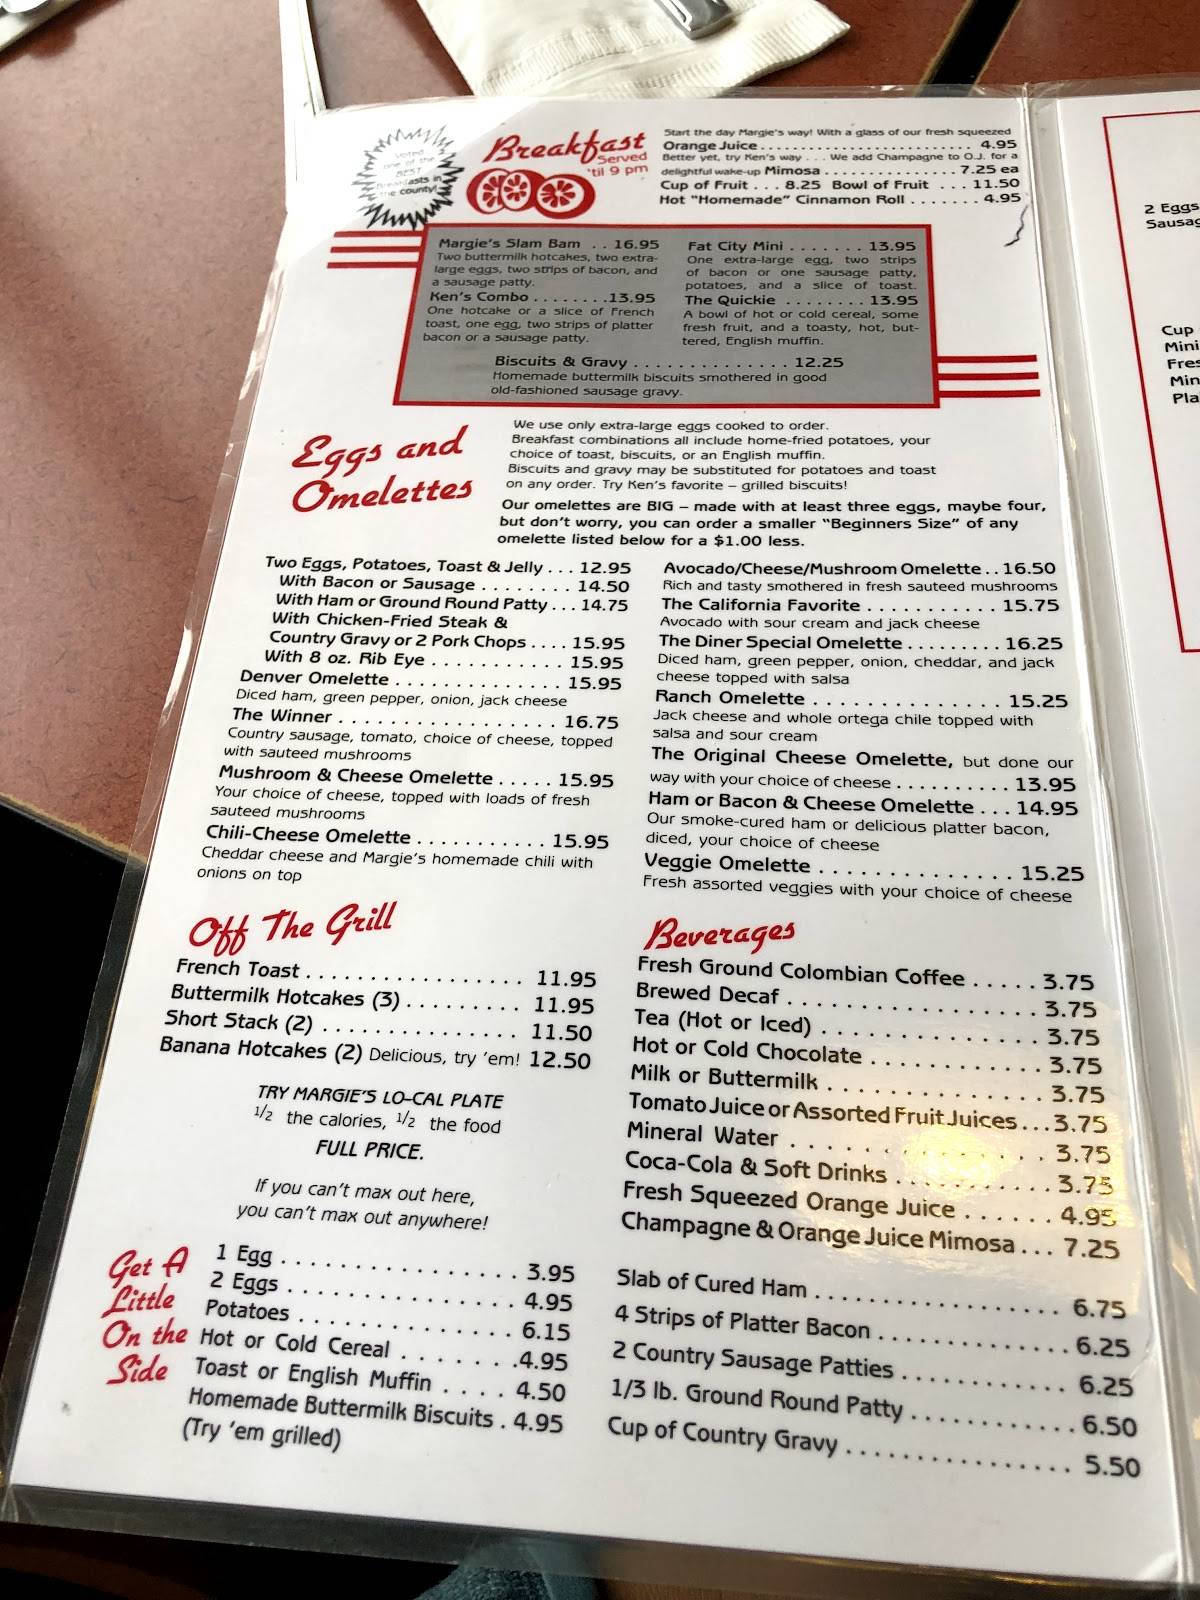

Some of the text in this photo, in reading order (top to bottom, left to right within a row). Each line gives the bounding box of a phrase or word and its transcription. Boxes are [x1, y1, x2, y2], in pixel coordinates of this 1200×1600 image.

[715, 129, 736, 137] day
[738, 129, 784, 138] Margie's
[787, 129, 813, 138] way!
[855, 129, 885, 138] glass
[958, 128, 1012, 137] squeezed
[482, 129, 646, 164] Breakfast
[663, 140, 1017, 152] Orange Juice 4.95
[598, 152, 648, 164] Served
[588, 165, 648, 177] 'til 9 pm
[660, 178, 1020, 192] Cup of Fruit 8.25 Bowl of Fruit 11.50
[660, 192, 1021, 204] Hot "Homemade" Cinnamon Roll 4.95
[1144, 203, 1200, 214] 2 Eggs
[438, 238, 660, 250] Margie's Slam Bam 16.95
[688, 240, 919, 254] Fat City Mini 13.95
[436, 252, 658, 265] Two buttermilk hotcakes, two extra-
[684, 294, 918, 308] The Quickie 13.95
[1162, 325, 1194, 337] Cup
[1165, 340, 1199, 352] Mini
[494, 355, 844, 371] Biscuits & Gravy 12.25
[514, 420, 534, 429] We
[568, 420, 596, 432] only
[600, 421, 672, 433] extra-large
[677, 423, 711, 433] eggs
[715, 421, 764, 430] cooked
[770, 422, 784, 430] to
[789, 421, 828, 430] order.
[292, 425, 469, 479] Eggs and
[292, 475, 474, 512] Omelettes
[266, 556, 631, 576] Two Eggs, Potatoes, Toast & Jelly 12.95
[661, 597, 1060, 612] The California Favorite 15.75
[660, 616, 980, 632] Avocado with sour cream and jack cheese
[240, 669, 622, 690] Denver Omelette 15.95
[236, 688, 568, 708] Diced ham, green pepper, onion, jack cheese
[233, 707, 618, 730] The Winner 16.75
[644, 852, 1085, 882] Veggie Omelette 15.25
[189, 901, 397, 957] Off The Grill
[643, 917, 796, 954] Beverages
[176, 958, 596, 988] French Toast 11.95
[636, 982, 1097, 1018] Brewed Decaf 3.75
[160, 1036, 591, 1070] Banana Hotcakes (2) Delicious, try 'em! 12.50
[316, 1140, 423, 1160] FULL PRICE.
[625, 1150, 1113, 1195] Coca-Cola & Soft Drinks 3.75
[255, 1178, 474, 1207] If you can't max out here,
[109, 1246, 189, 1288] Get A
[216, 1244, 575, 1283] 1 Egg 3.95
[101, 1283, 175, 1318] Little
[205, 1299, 570, 1342] Potatoes 6.15
[103, 1317, 188, 1348] On the
[106, 1354, 168, 1384] Side
[608, 1416, 1141, 1478] Cup of Country Gravy 5.50
